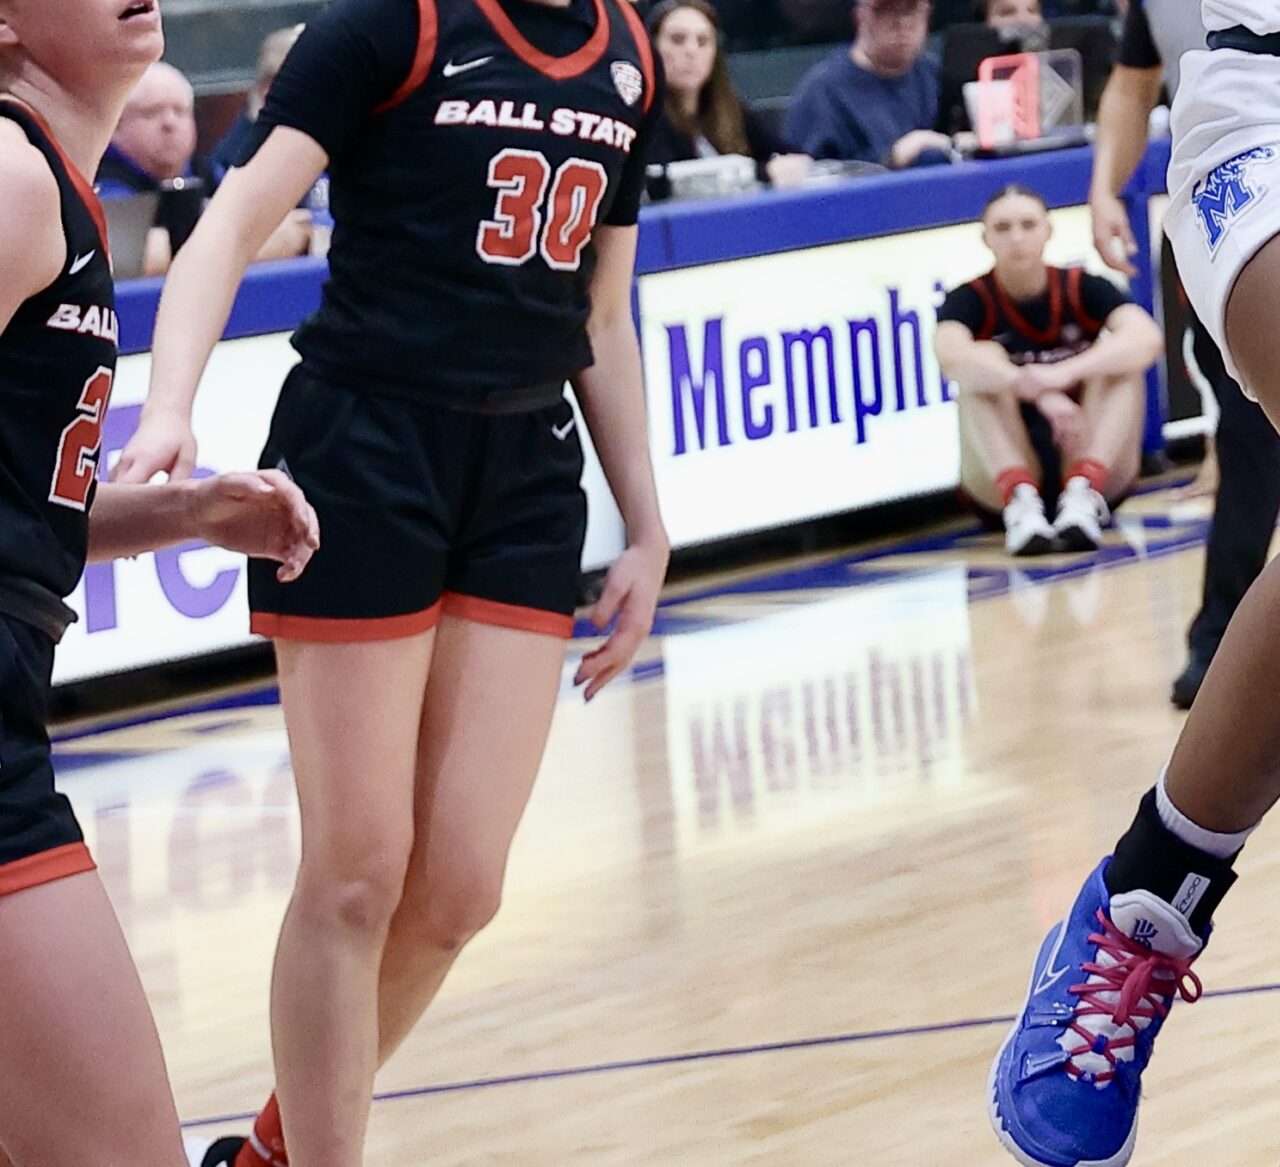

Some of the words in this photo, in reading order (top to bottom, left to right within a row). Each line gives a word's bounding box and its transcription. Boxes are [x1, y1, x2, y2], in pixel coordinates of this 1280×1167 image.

[434, 99, 545, 130] BALL
[475, 147, 609, 272] 30
[664, 280, 956, 456] Memph
